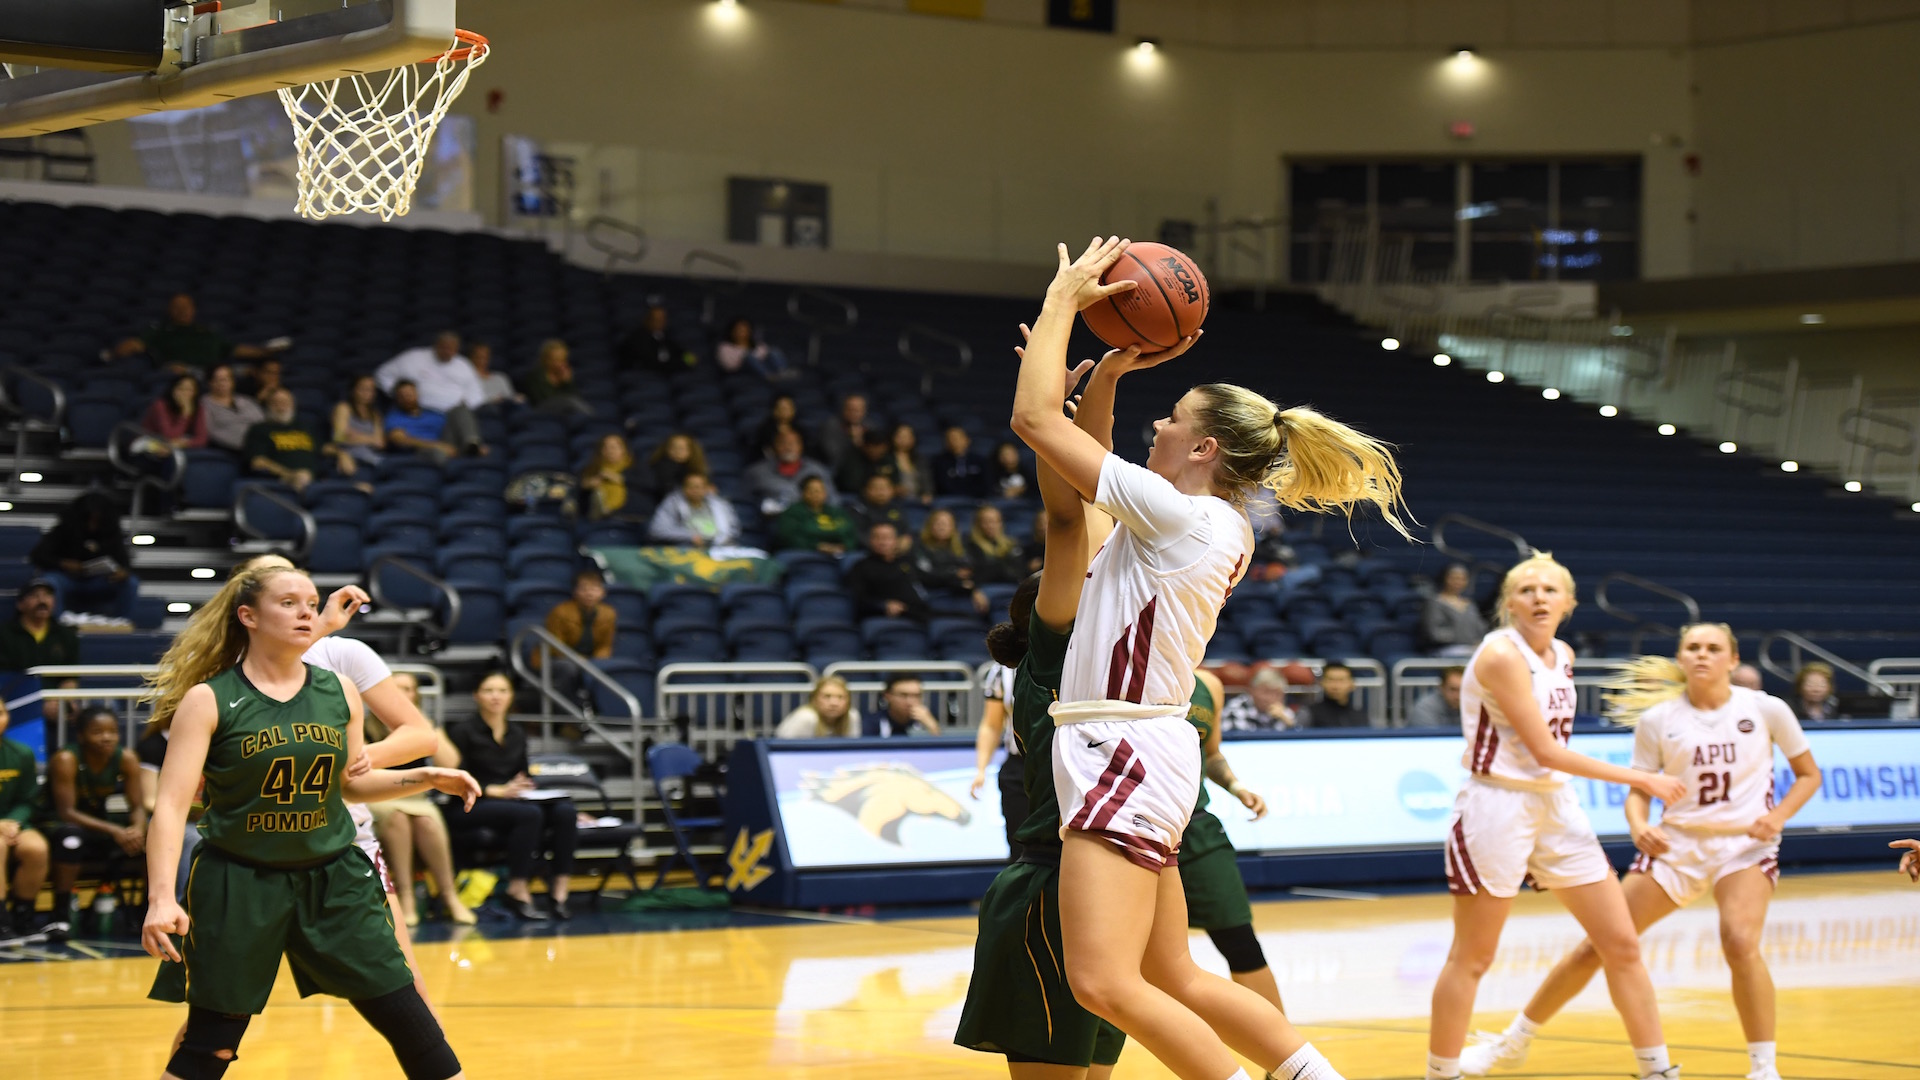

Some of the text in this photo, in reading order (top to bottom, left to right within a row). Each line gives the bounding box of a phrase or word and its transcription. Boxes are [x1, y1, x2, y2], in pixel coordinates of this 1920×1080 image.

[1160, 257, 1199, 304] NCAA
[241, 723, 342, 759] CAL POLY
[1693, 743, 1736, 766] APU
[261, 754, 335, 804] 44
[1699, 772, 1731, 806] 21
